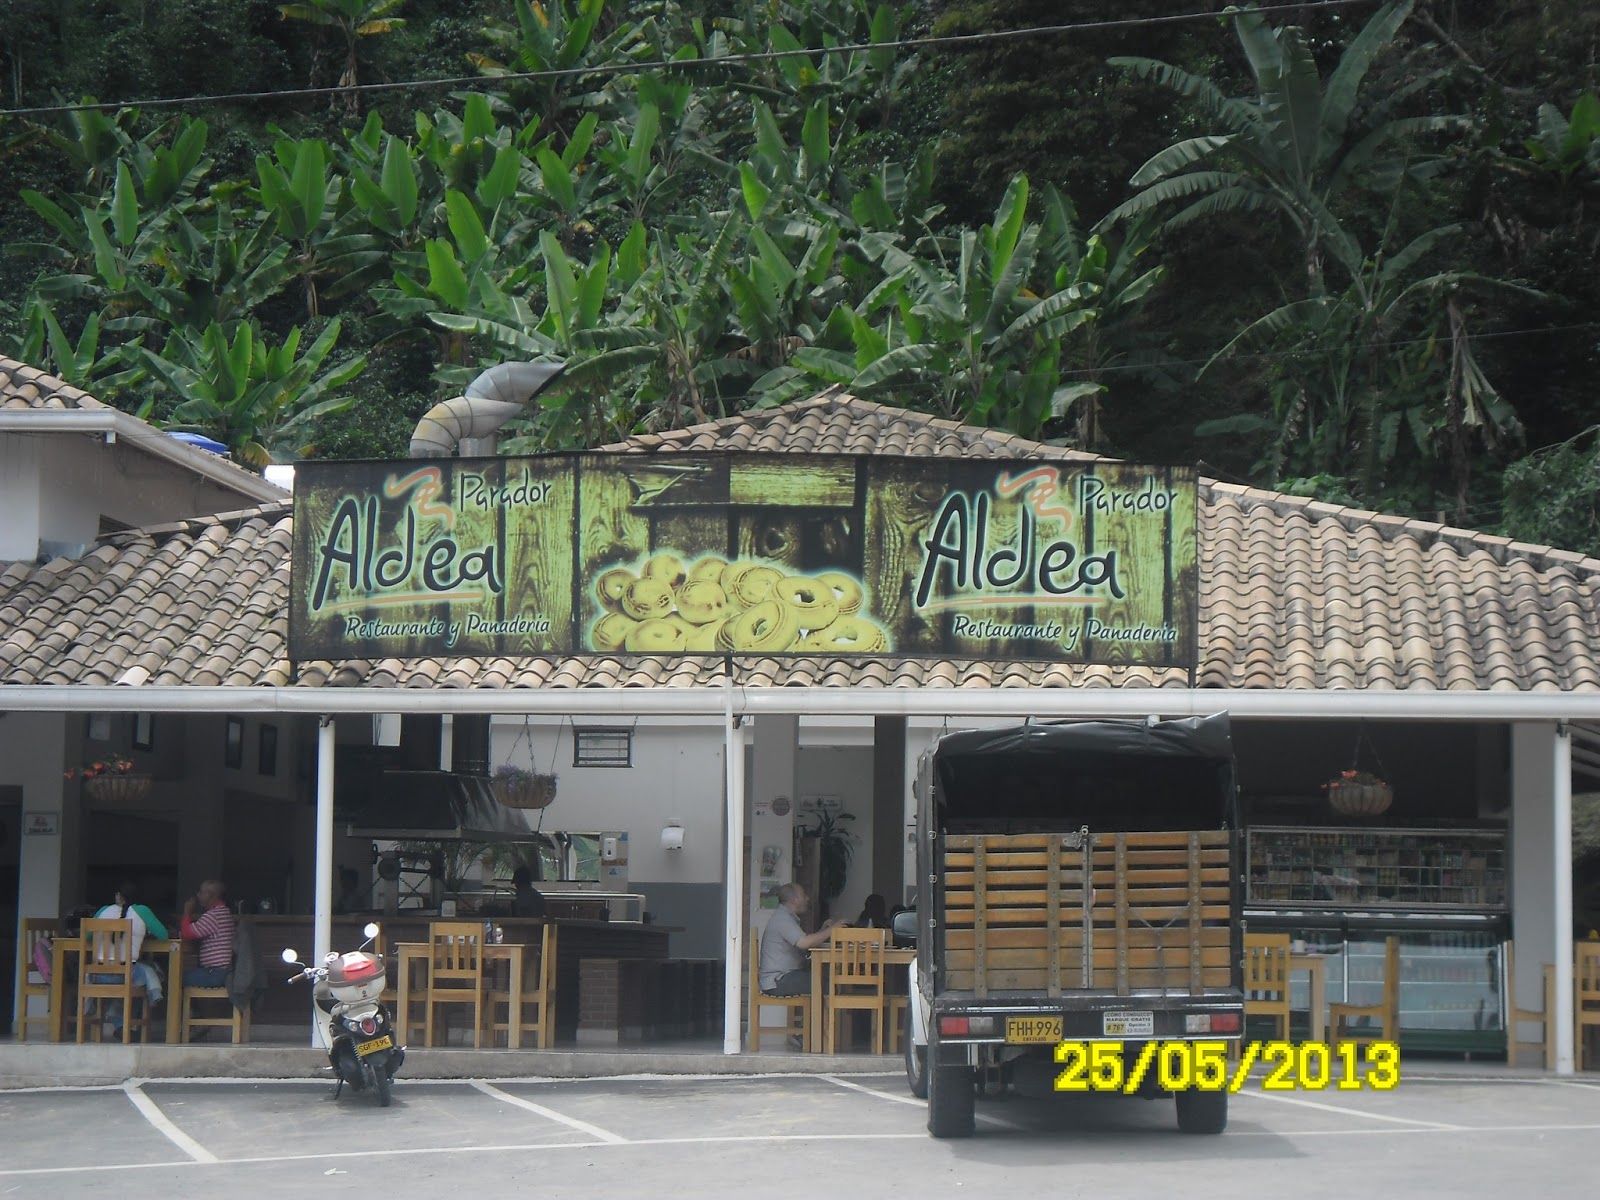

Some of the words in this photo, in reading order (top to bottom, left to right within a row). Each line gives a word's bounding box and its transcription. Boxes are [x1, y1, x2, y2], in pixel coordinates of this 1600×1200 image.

[460, 468, 552, 513] Parador
[1080, 475, 1179, 515] Parador
[312, 495, 501, 611] Aldea
[916, 492, 1126, 607] Aldea
[346, 617, 444, 637] Restaurante
[446, 622, 460, 647] y
[954, 615, 1063, 640] Restaurante
[1065, 625, 1080, 651] y
